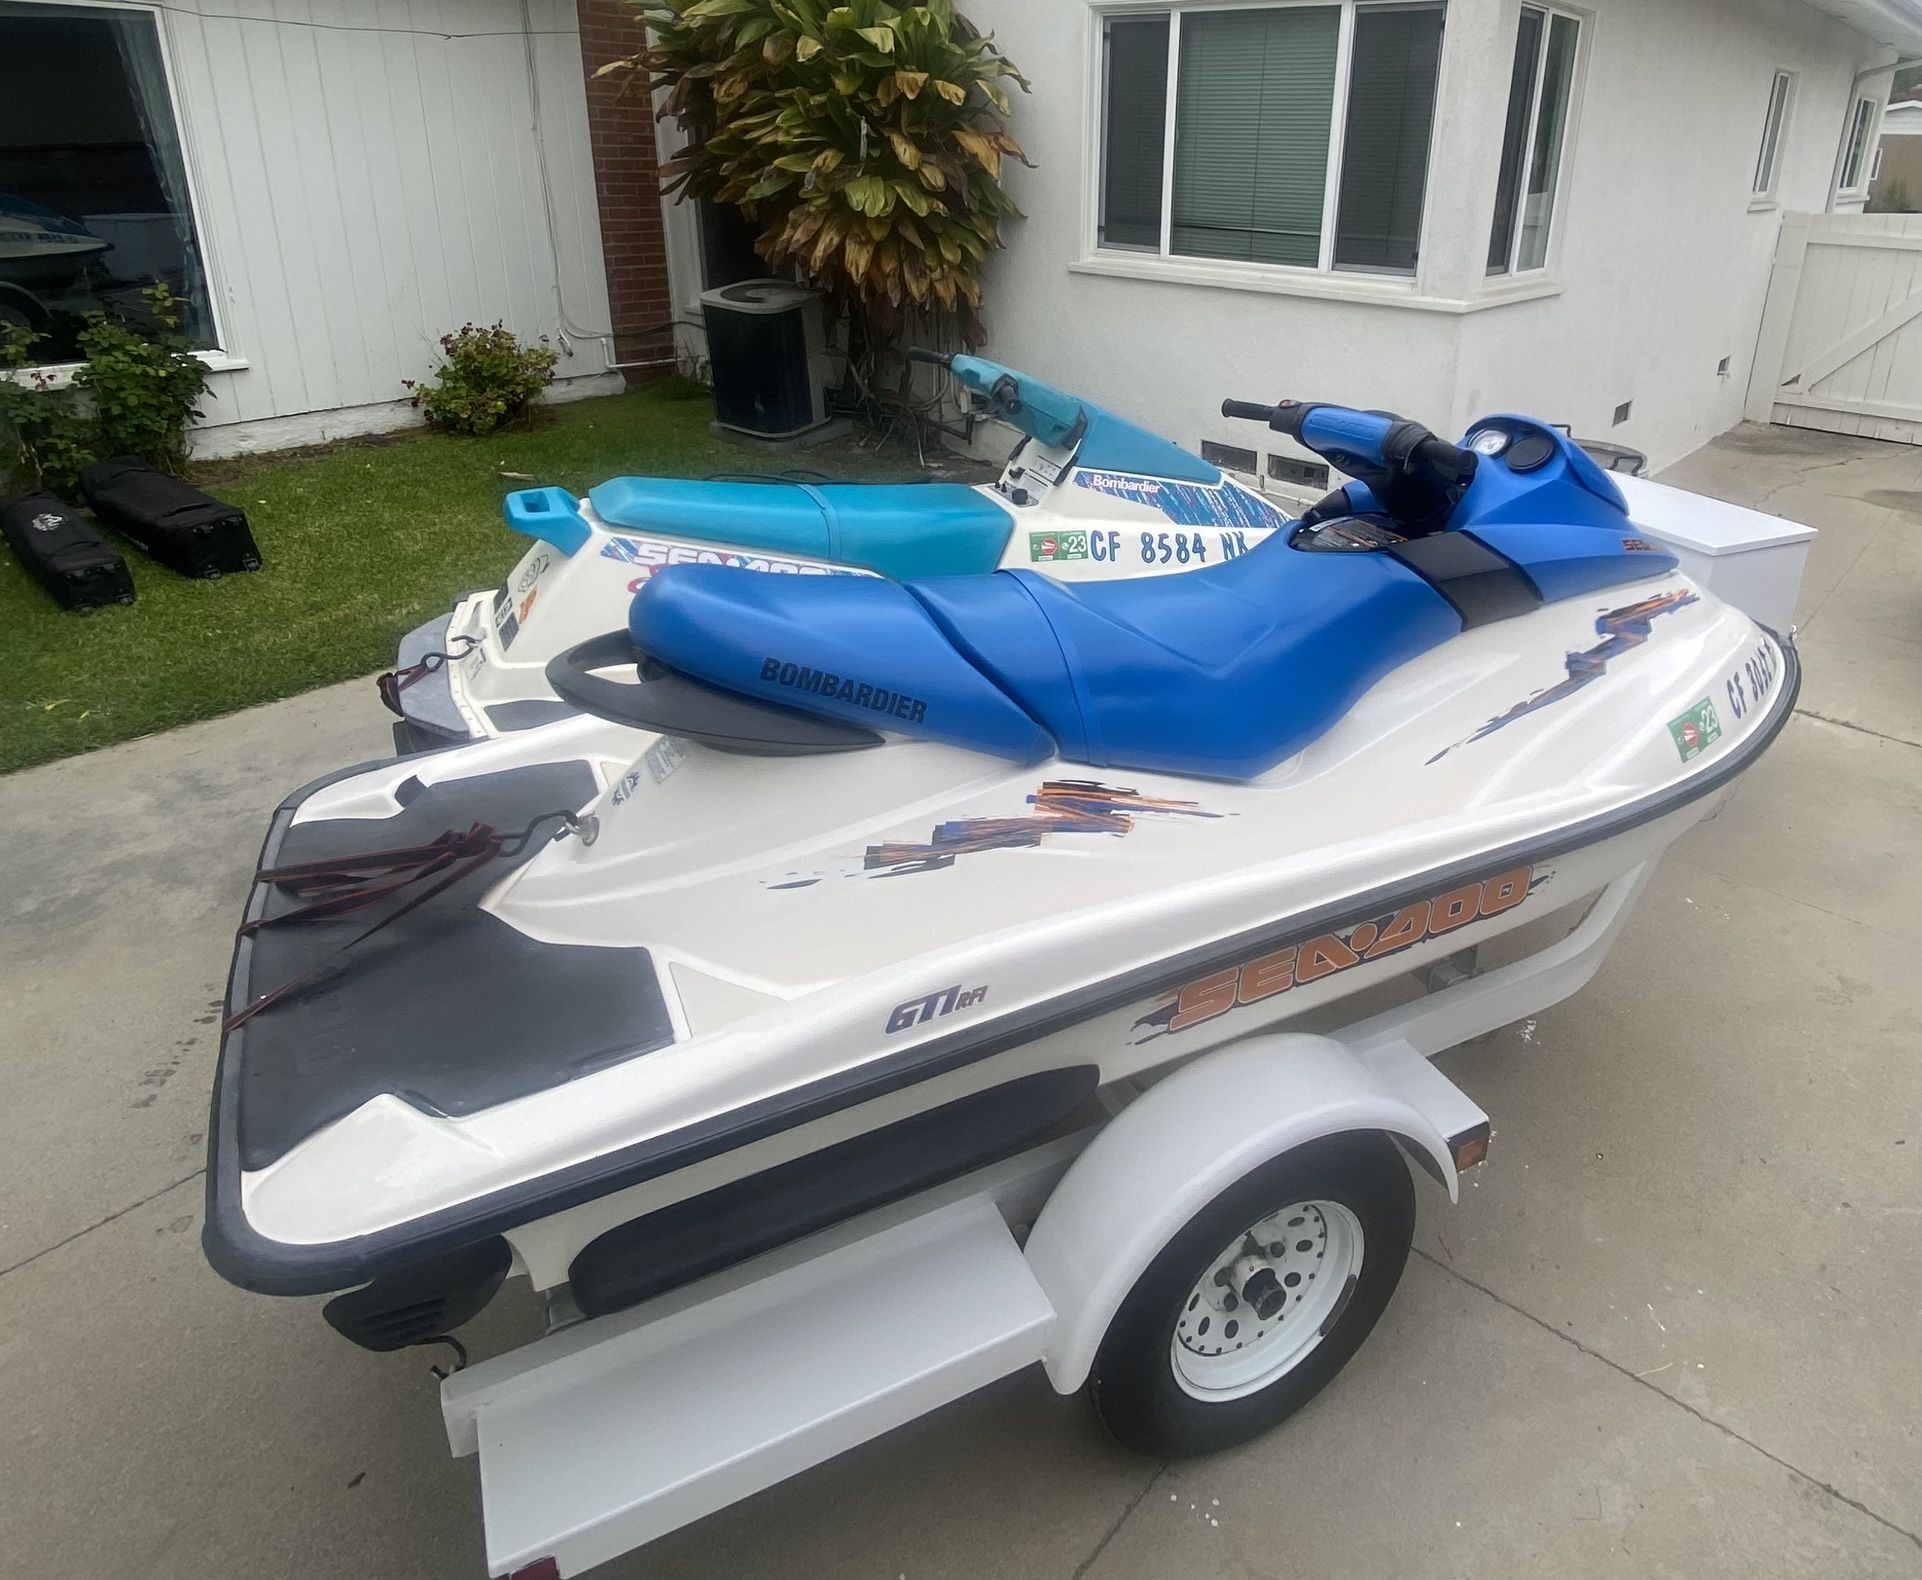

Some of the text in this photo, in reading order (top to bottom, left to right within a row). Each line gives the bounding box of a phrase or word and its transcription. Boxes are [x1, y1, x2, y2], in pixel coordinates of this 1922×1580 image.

[1092, 475, 1160, 493] Bombardier
[1068, 535, 1087, 553] 23
[1090, 530, 1121, 561] CF
[1140, 531, 1206, 563] 8584
[759, 656, 928, 724] BOMBARDIER
[1726, 671, 1747, 719] CF
[1701, 704, 1718, 733] 23
[885, 984, 962, 1035] GTI
